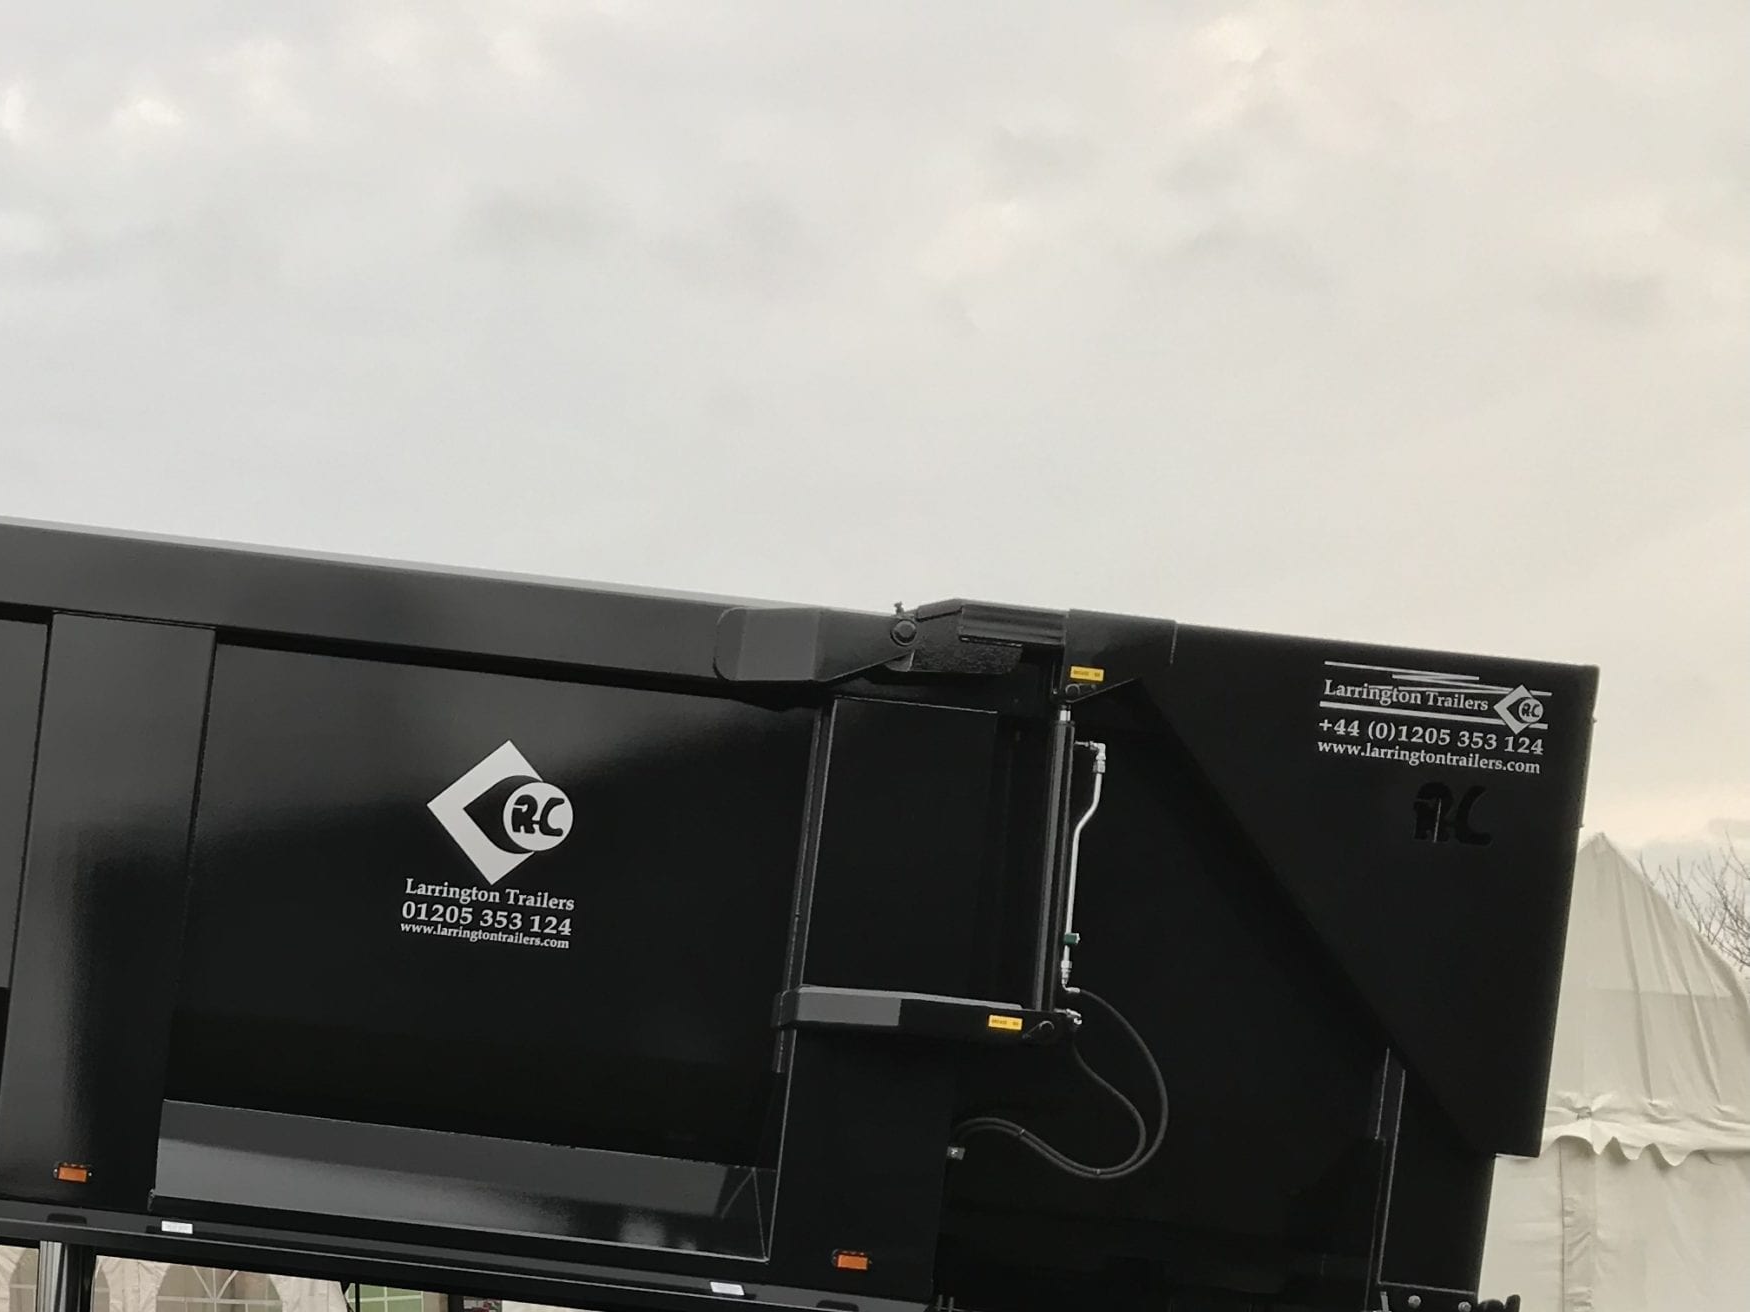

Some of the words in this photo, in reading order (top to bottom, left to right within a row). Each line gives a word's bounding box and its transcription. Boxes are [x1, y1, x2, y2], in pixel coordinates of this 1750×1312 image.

[1324, 679, 1422, 705] Larrington
[1426, 690, 1489, 711] Trailers
[1318, 718, 1360, 737] +44
[1368, 720, 1451, 745] (0)1205
[1457, 730, 1497, 749] 353
[1504, 736, 1544, 755] 124
[1317, 740, 1541, 774] www.larringtontrailers.com
[511, 794, 565, 837] RC
[405, 878, 500, 904] Larrington
[505, 888, 575, 911] Trailers
[402, 901, 473, 924] 01205
[479, 909, 522, 930] 353
[530, 915, 572, 936] 124
[400, 923, 570, 949] www.larringtontrailers.com
